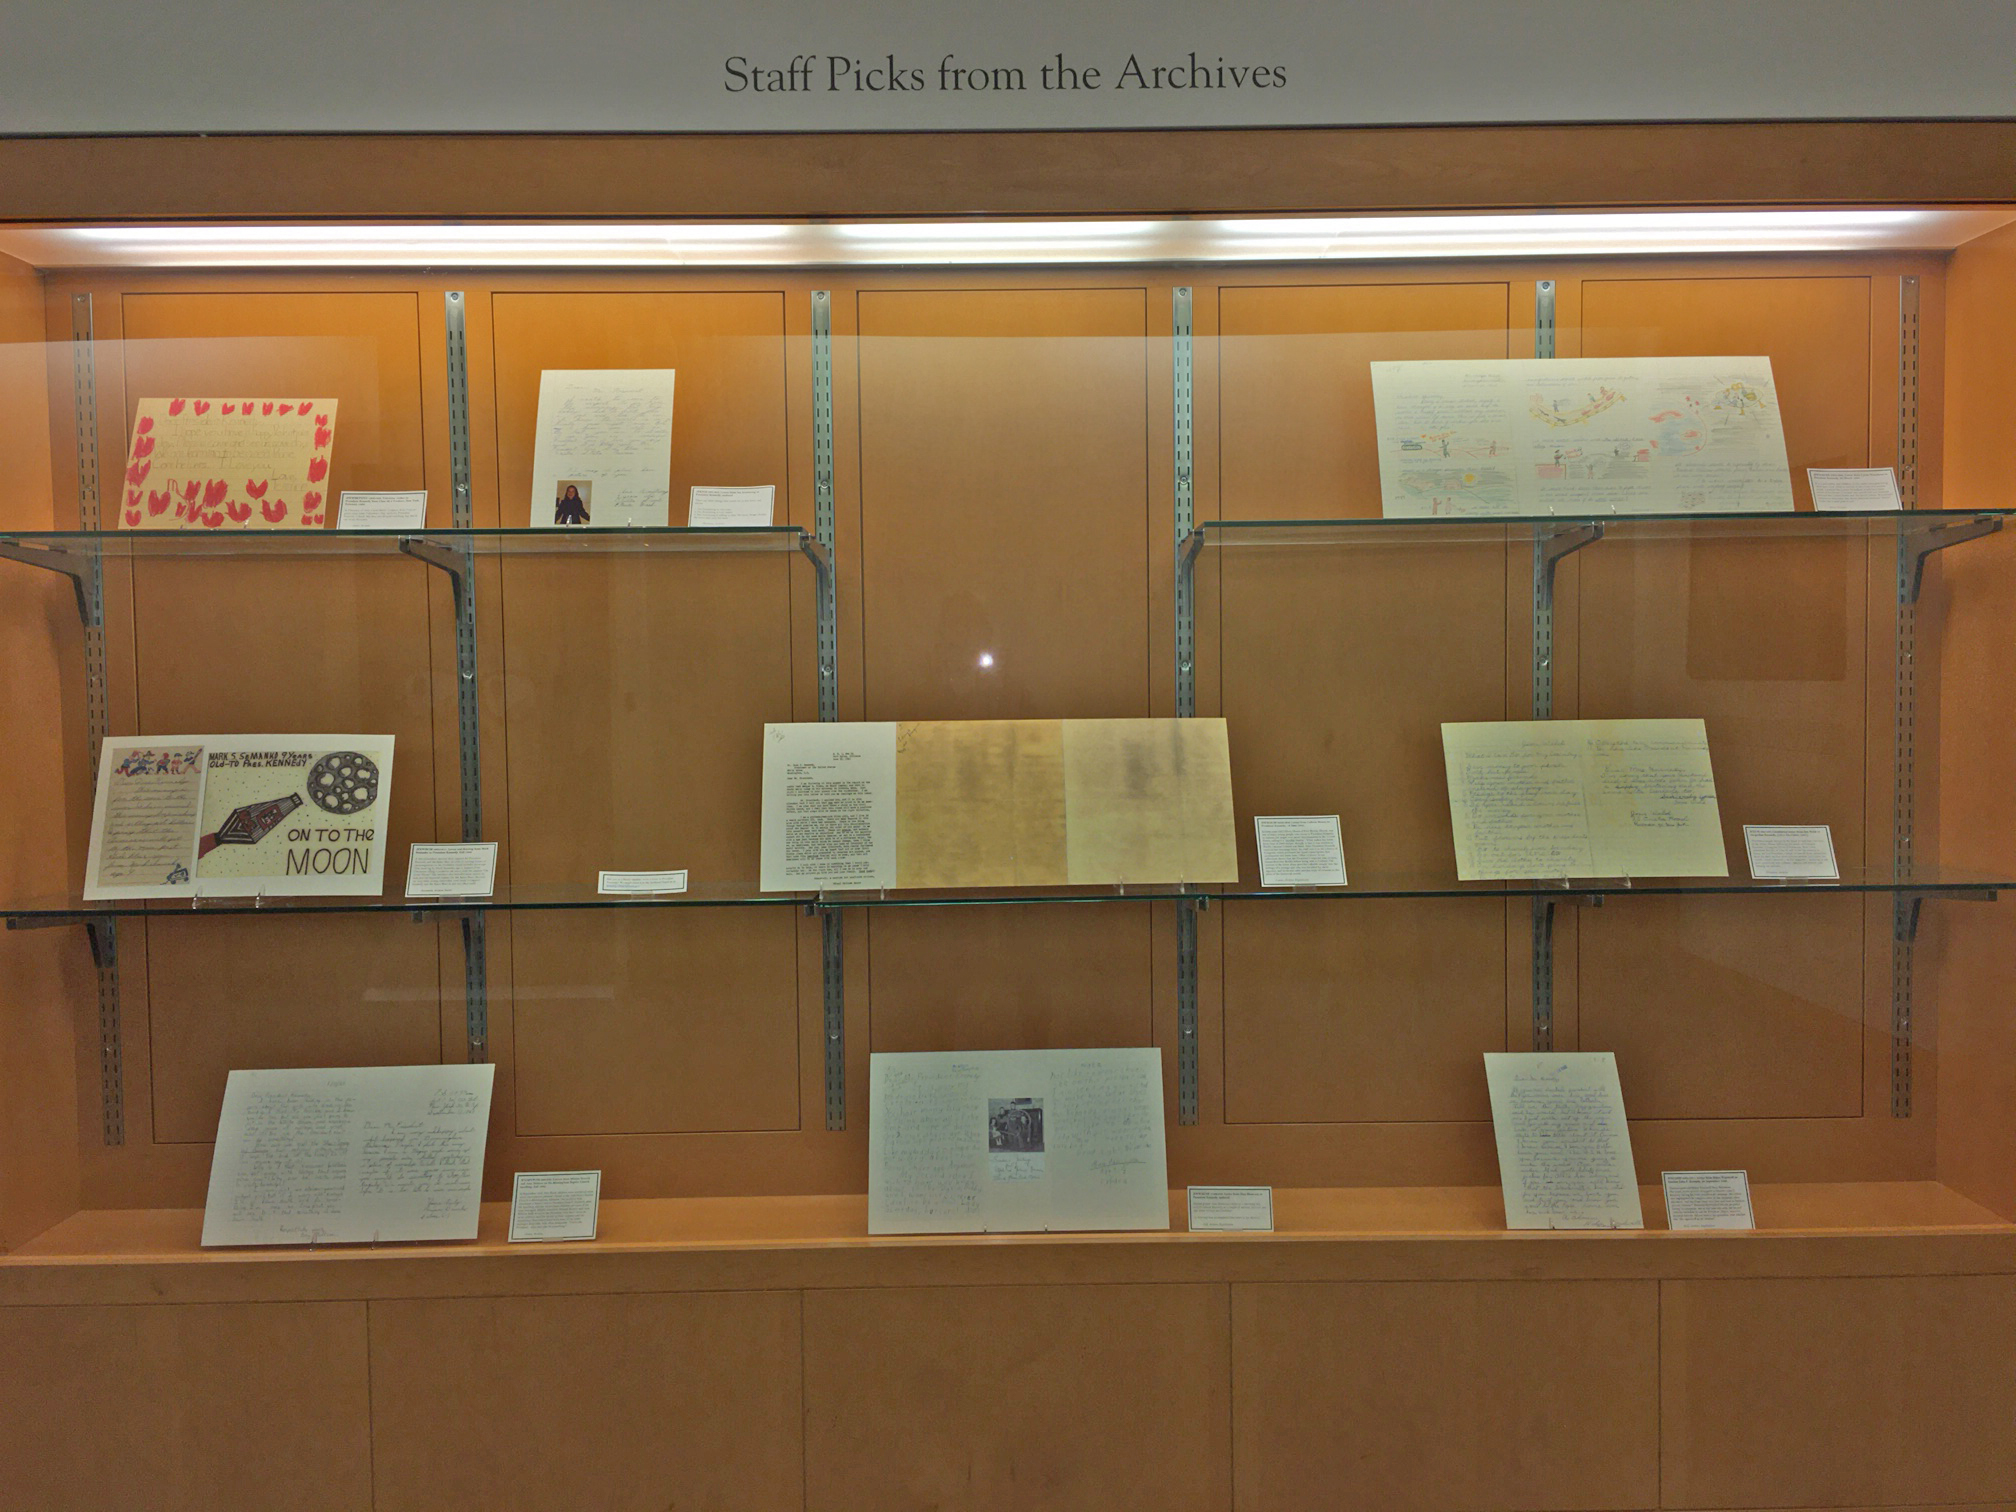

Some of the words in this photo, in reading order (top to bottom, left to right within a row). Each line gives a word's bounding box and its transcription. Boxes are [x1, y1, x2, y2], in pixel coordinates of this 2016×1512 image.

[725, 56, 817, 93] Staff
[828, 55, 925, 92] Picks
[938, 55, 1025, 91] from
[1041, 54, 1101, 91] the
[1115, 53, 1287, 90] Archives
[209, 752, 228, 761] MARK
[288, 828, 312, 842] ON
[315, 828, 341, 842] TO
[285, 847, 370, 876] MOON
